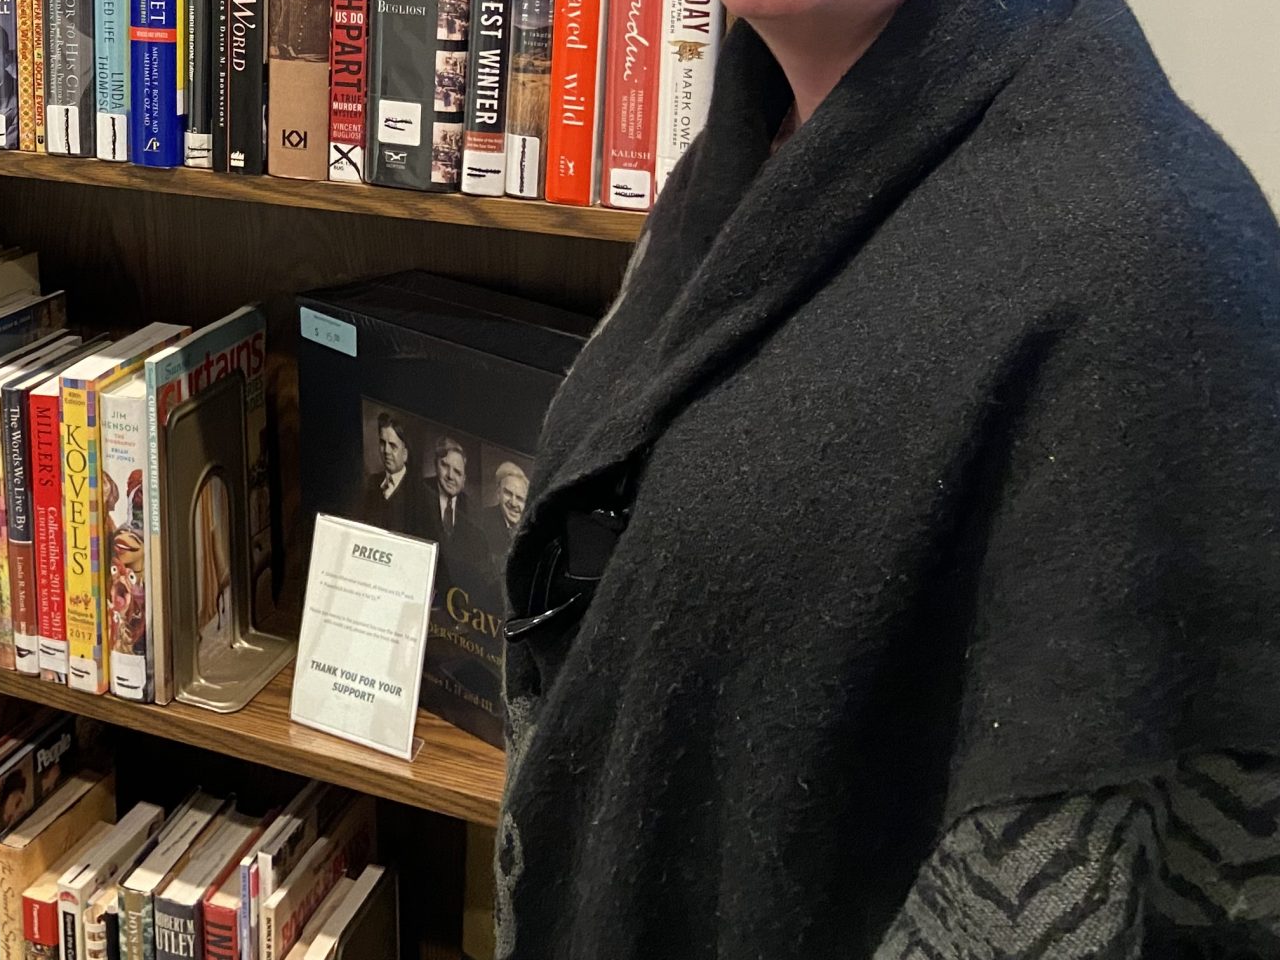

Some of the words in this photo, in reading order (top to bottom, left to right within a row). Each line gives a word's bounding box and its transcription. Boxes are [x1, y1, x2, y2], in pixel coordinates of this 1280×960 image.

[377, 0, 426, 16] BUGLIOSI
[334, 25, 363, 93] PART
[111, 72, 125, 109] LINDA
[476, 49, 501, 124] WINTER
[563, 74, 584, 126] Wild
[682, 68, 692, 108] MARK
[333, 102, 362, 112] MURDER
[611, 149, 651, 159] KALUSH
[10, 407, 19, 428] The
[103, 422, 139, 432] HENSON
[111, 411, 127, 419] JIM
[12, 431, 22, 463] Words
[36, 407, 52, 487] MILLER'S
[14, 465, 24, 484] We
[15, 487, 25, 514] Live
[17, 517, 24, 531] By
[48, 507, 58, 569] Collectibles
[352, 543, 392, 565] PRICES
[70, 628, 92, 640] 2017
[311, 660, 338, 676] THANK
[340, 669, 358, 682] YOU
[359, 675, 376, 688] FOR
[378, 680, 402, 697] YOUR
[332, 682, 375, 703] SUPPORT!
[36, 732, 71, 774] People
[155, 931, 197, 958] UTLEY
